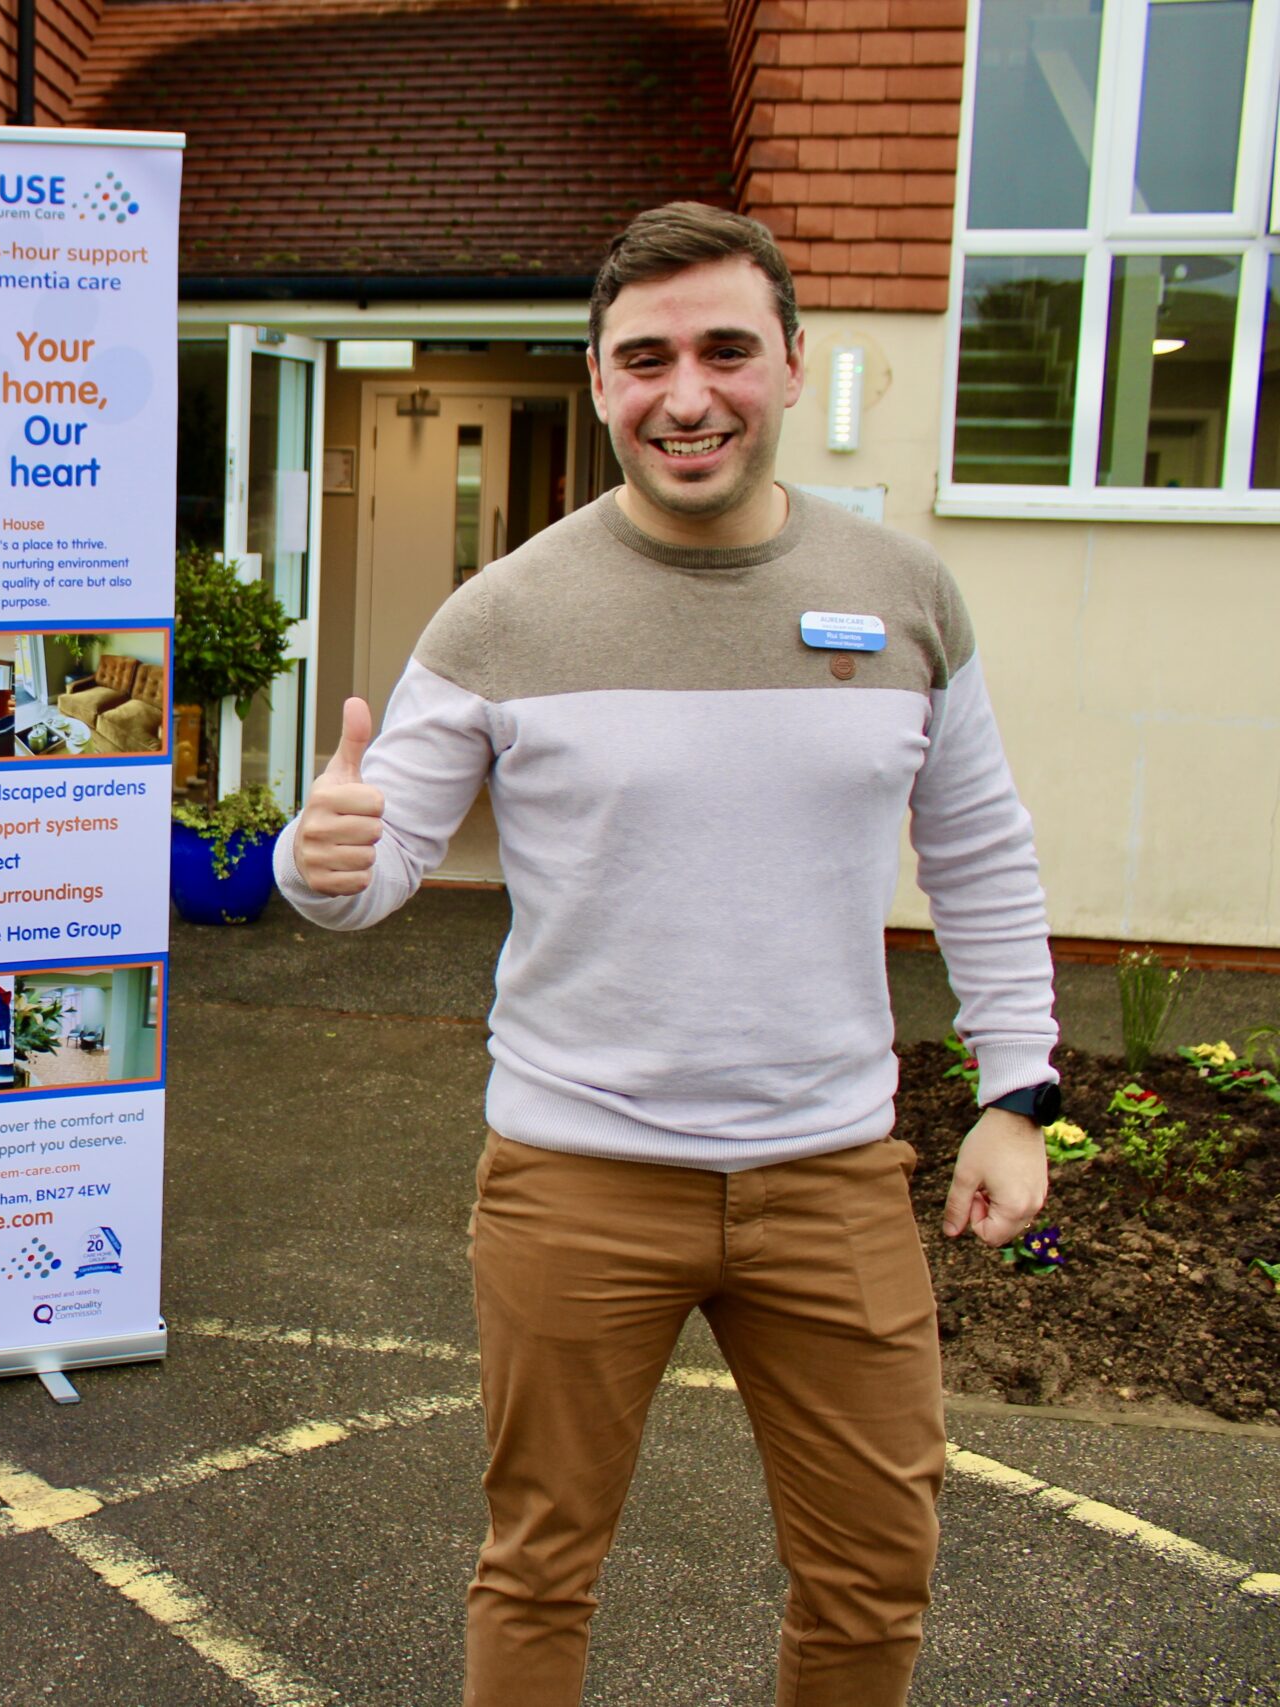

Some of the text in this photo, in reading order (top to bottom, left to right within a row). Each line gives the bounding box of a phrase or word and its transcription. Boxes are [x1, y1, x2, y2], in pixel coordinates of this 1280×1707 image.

[34, 208, 65, 220] Care
[67, 247, 148, 266] support
[77, 277, 121, 290] care
[16, 331, 95, 362] Your
[2, 371, 107, 410] home,
[24, 415, 87, 445] Our
[11, 455, 100, 487] heart
[3, 518, 44, 530] House
[11, 542, 19, 550] a
[22, 538, 53, 552] place
[56, 539, 68, 549] to
[71, 538, 106, 549] thrive.
[2, 557, 54, 571] nurturing
[57, 557, 129, 568] environment
[2, 576, 40, 591] quality
[43, 576, 55, 587] of
[58, 578, 83, 587] care
[87, 576, 105, 587] but
[109, 576, 131, 587] also
[1, 598, 49, 610] purpose.
[72, 779, 145, 801] gardens
[46, 816, 118, 836] systems
[7, 926, 60, 941] Home
[66, 922, 121, 939] Group
[33, 1117, 56, 1130] the
[60, 1112, 114, 1127] comfort
[118, 1108, 144, 1123] and
[40, 1141, 64, 1154] you
[69, 1135, 126, 1148] deserve.
[36, 1186, 74, 1201] BN27
[78, 1183, 110, 1196] 4EW
[87, 1239, 104, 1252] 20
